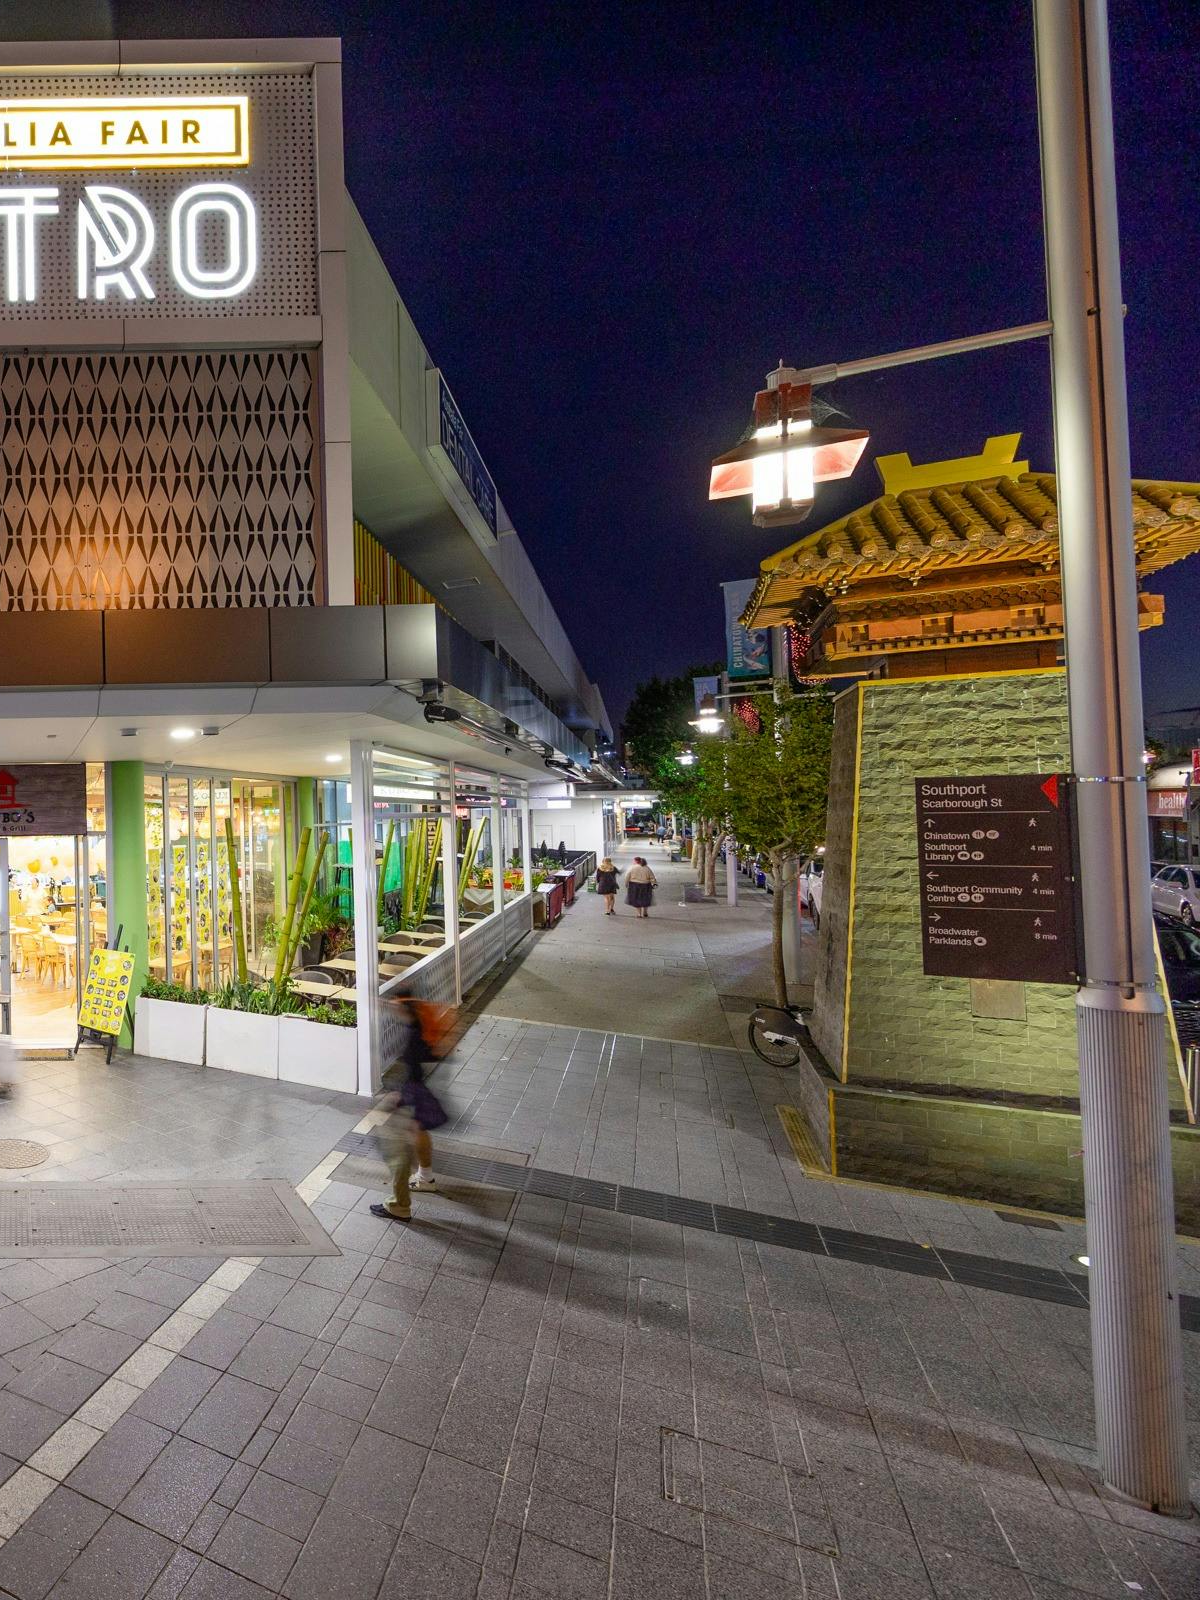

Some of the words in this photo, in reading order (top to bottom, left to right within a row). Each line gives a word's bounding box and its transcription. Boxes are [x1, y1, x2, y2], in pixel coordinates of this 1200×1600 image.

[101, 118, 204, 145] FAIR
[921, 783, 987, 797] Southport
[922, 797, 988, 810] Scarborough
[990, 798, 1003, 808] St
[1158, 791, 1184, 809] health
[923, 831, 970, 841] Chinatown
[924, 843, 967, 854] Southport
[1030, 844, 1036, 852] 4
[1037, 844, 1053, 852] min
[925, 852, 956, 863] Library
[926, 884, 969, 895] Southport
[970, 885, 1023, 896] Community
[1032, 888, 1038, 896] 4
[1039, 888, 1055, 896] min
[927, 894, 956, 903] Centre
[928, 927, 979, 937] Broadwater
[929, 936, 972, 947] Parklands
